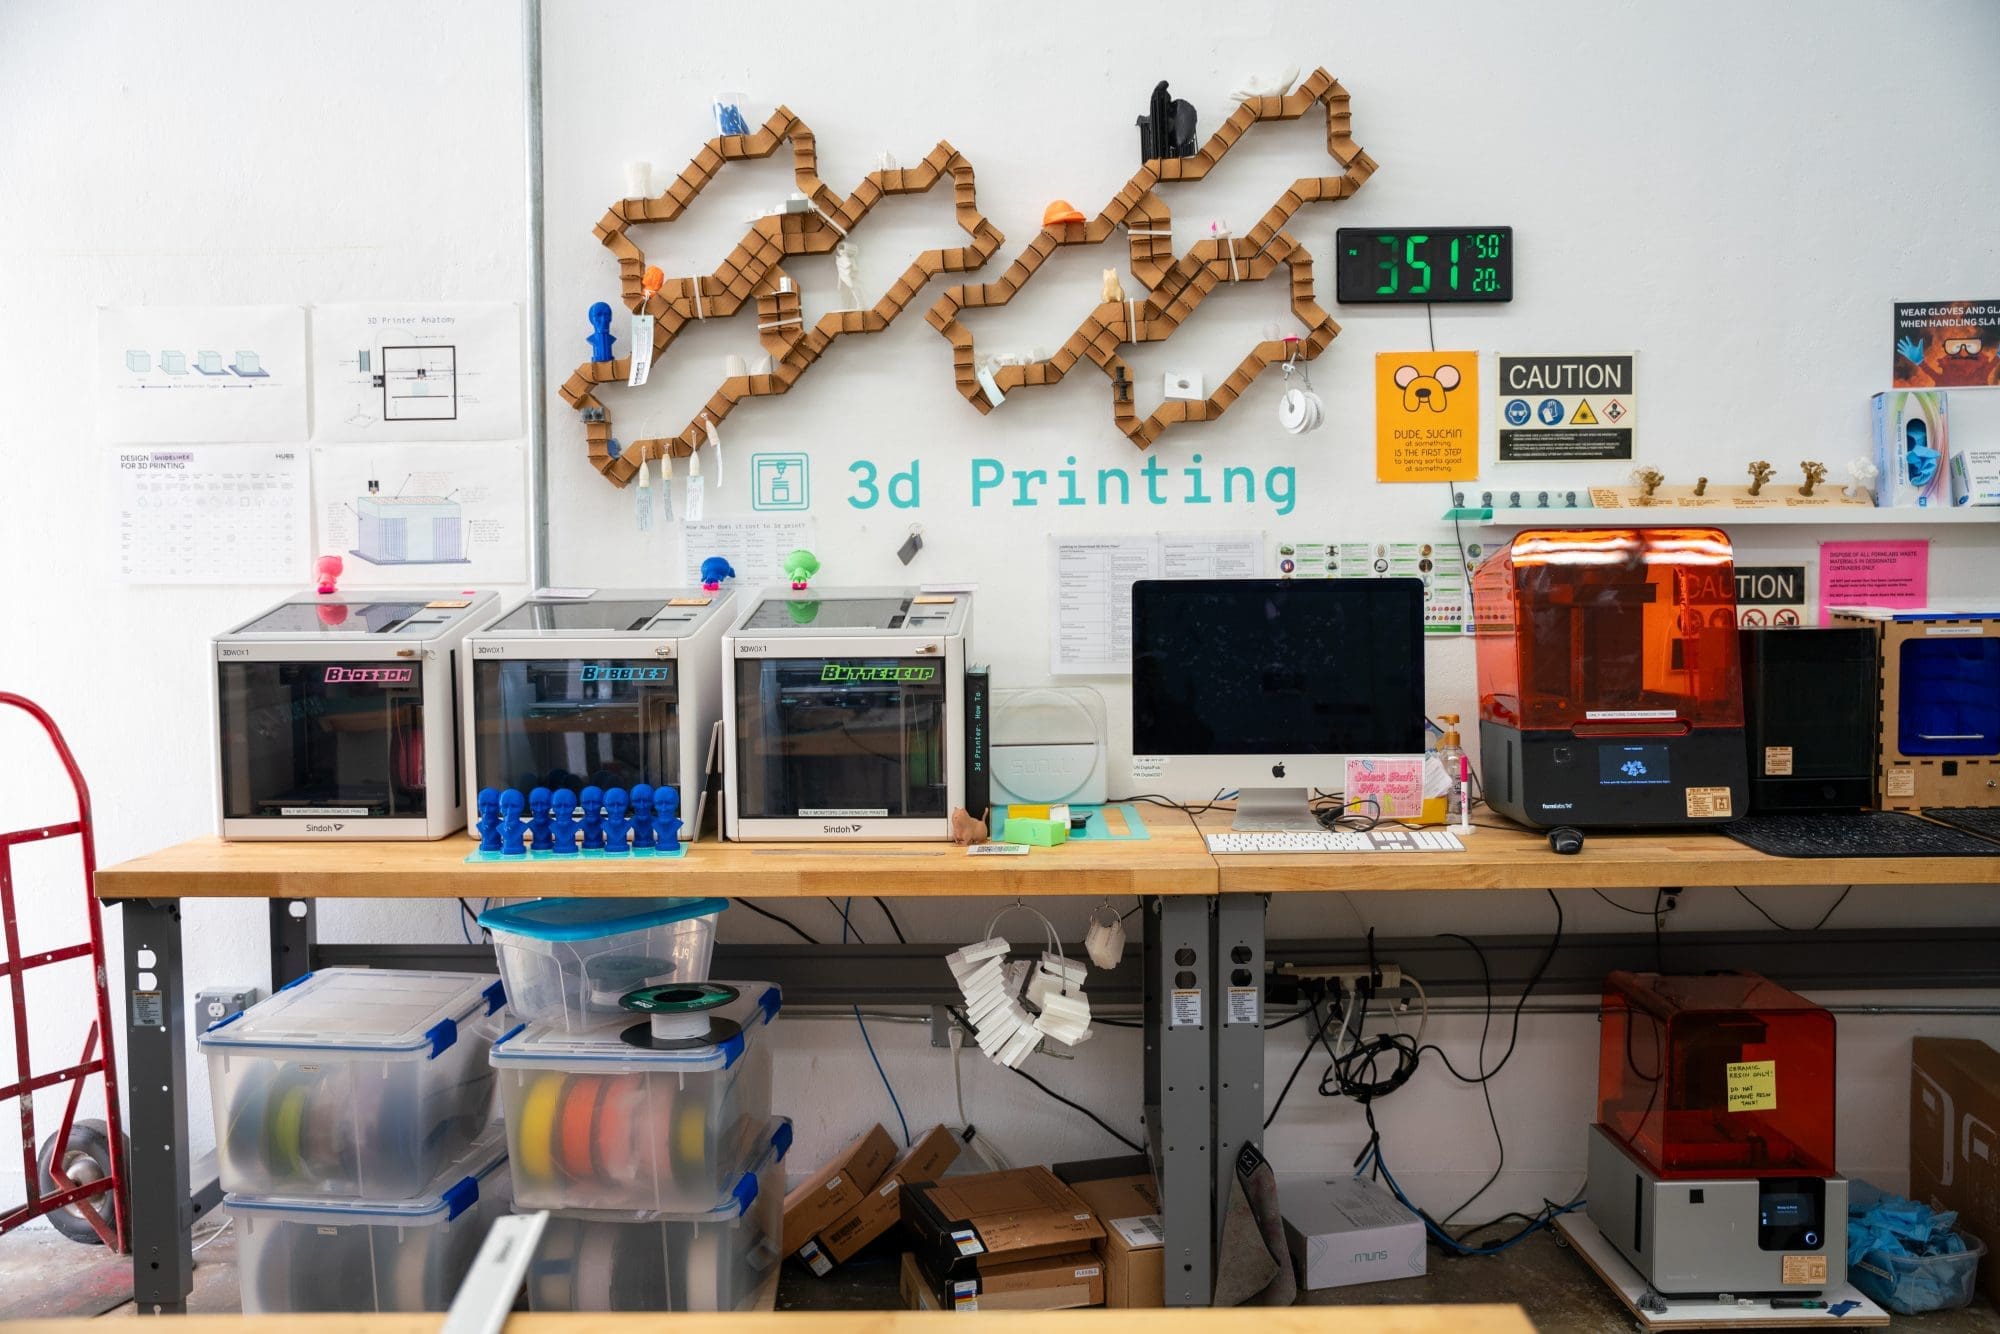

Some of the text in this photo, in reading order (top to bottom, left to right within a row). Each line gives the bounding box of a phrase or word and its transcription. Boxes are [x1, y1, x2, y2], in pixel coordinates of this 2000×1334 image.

[1900, 308, 1926, 317] WEAR
[1928, 307, 1964, 316] GLOVES
[1965, 306, 1985, 315] AND
[367, 316, 456, 326] 3D Printer Anatomy
[1900, 318, 1996, 328] WHEN HANDLING SLA
[1509, 364, 1621, 389] CAUTION
[1394, 430, 1423, 440] DUDE,
[1394, 449, 1402, 457] IS
[1422, 448, 1442, 456] FIRST
[1444, 448, 1462, 456] STEP
[120, 454, 149, 462] DESIGN
[1404, 458, 1422, 466] being
[1444, 457, 1462, 465] good
[120, 462, 136, 470] FOR
[150, 462, 184, 470] PRINTING
[847, 454, 1296, 516] 3d Printing
[974, 692, 981, 702] To
[974, 762, 981, 772] 3d
[306, 824, 333, 832] Sindoh
[824, 825, 851, 833] Sindoh
